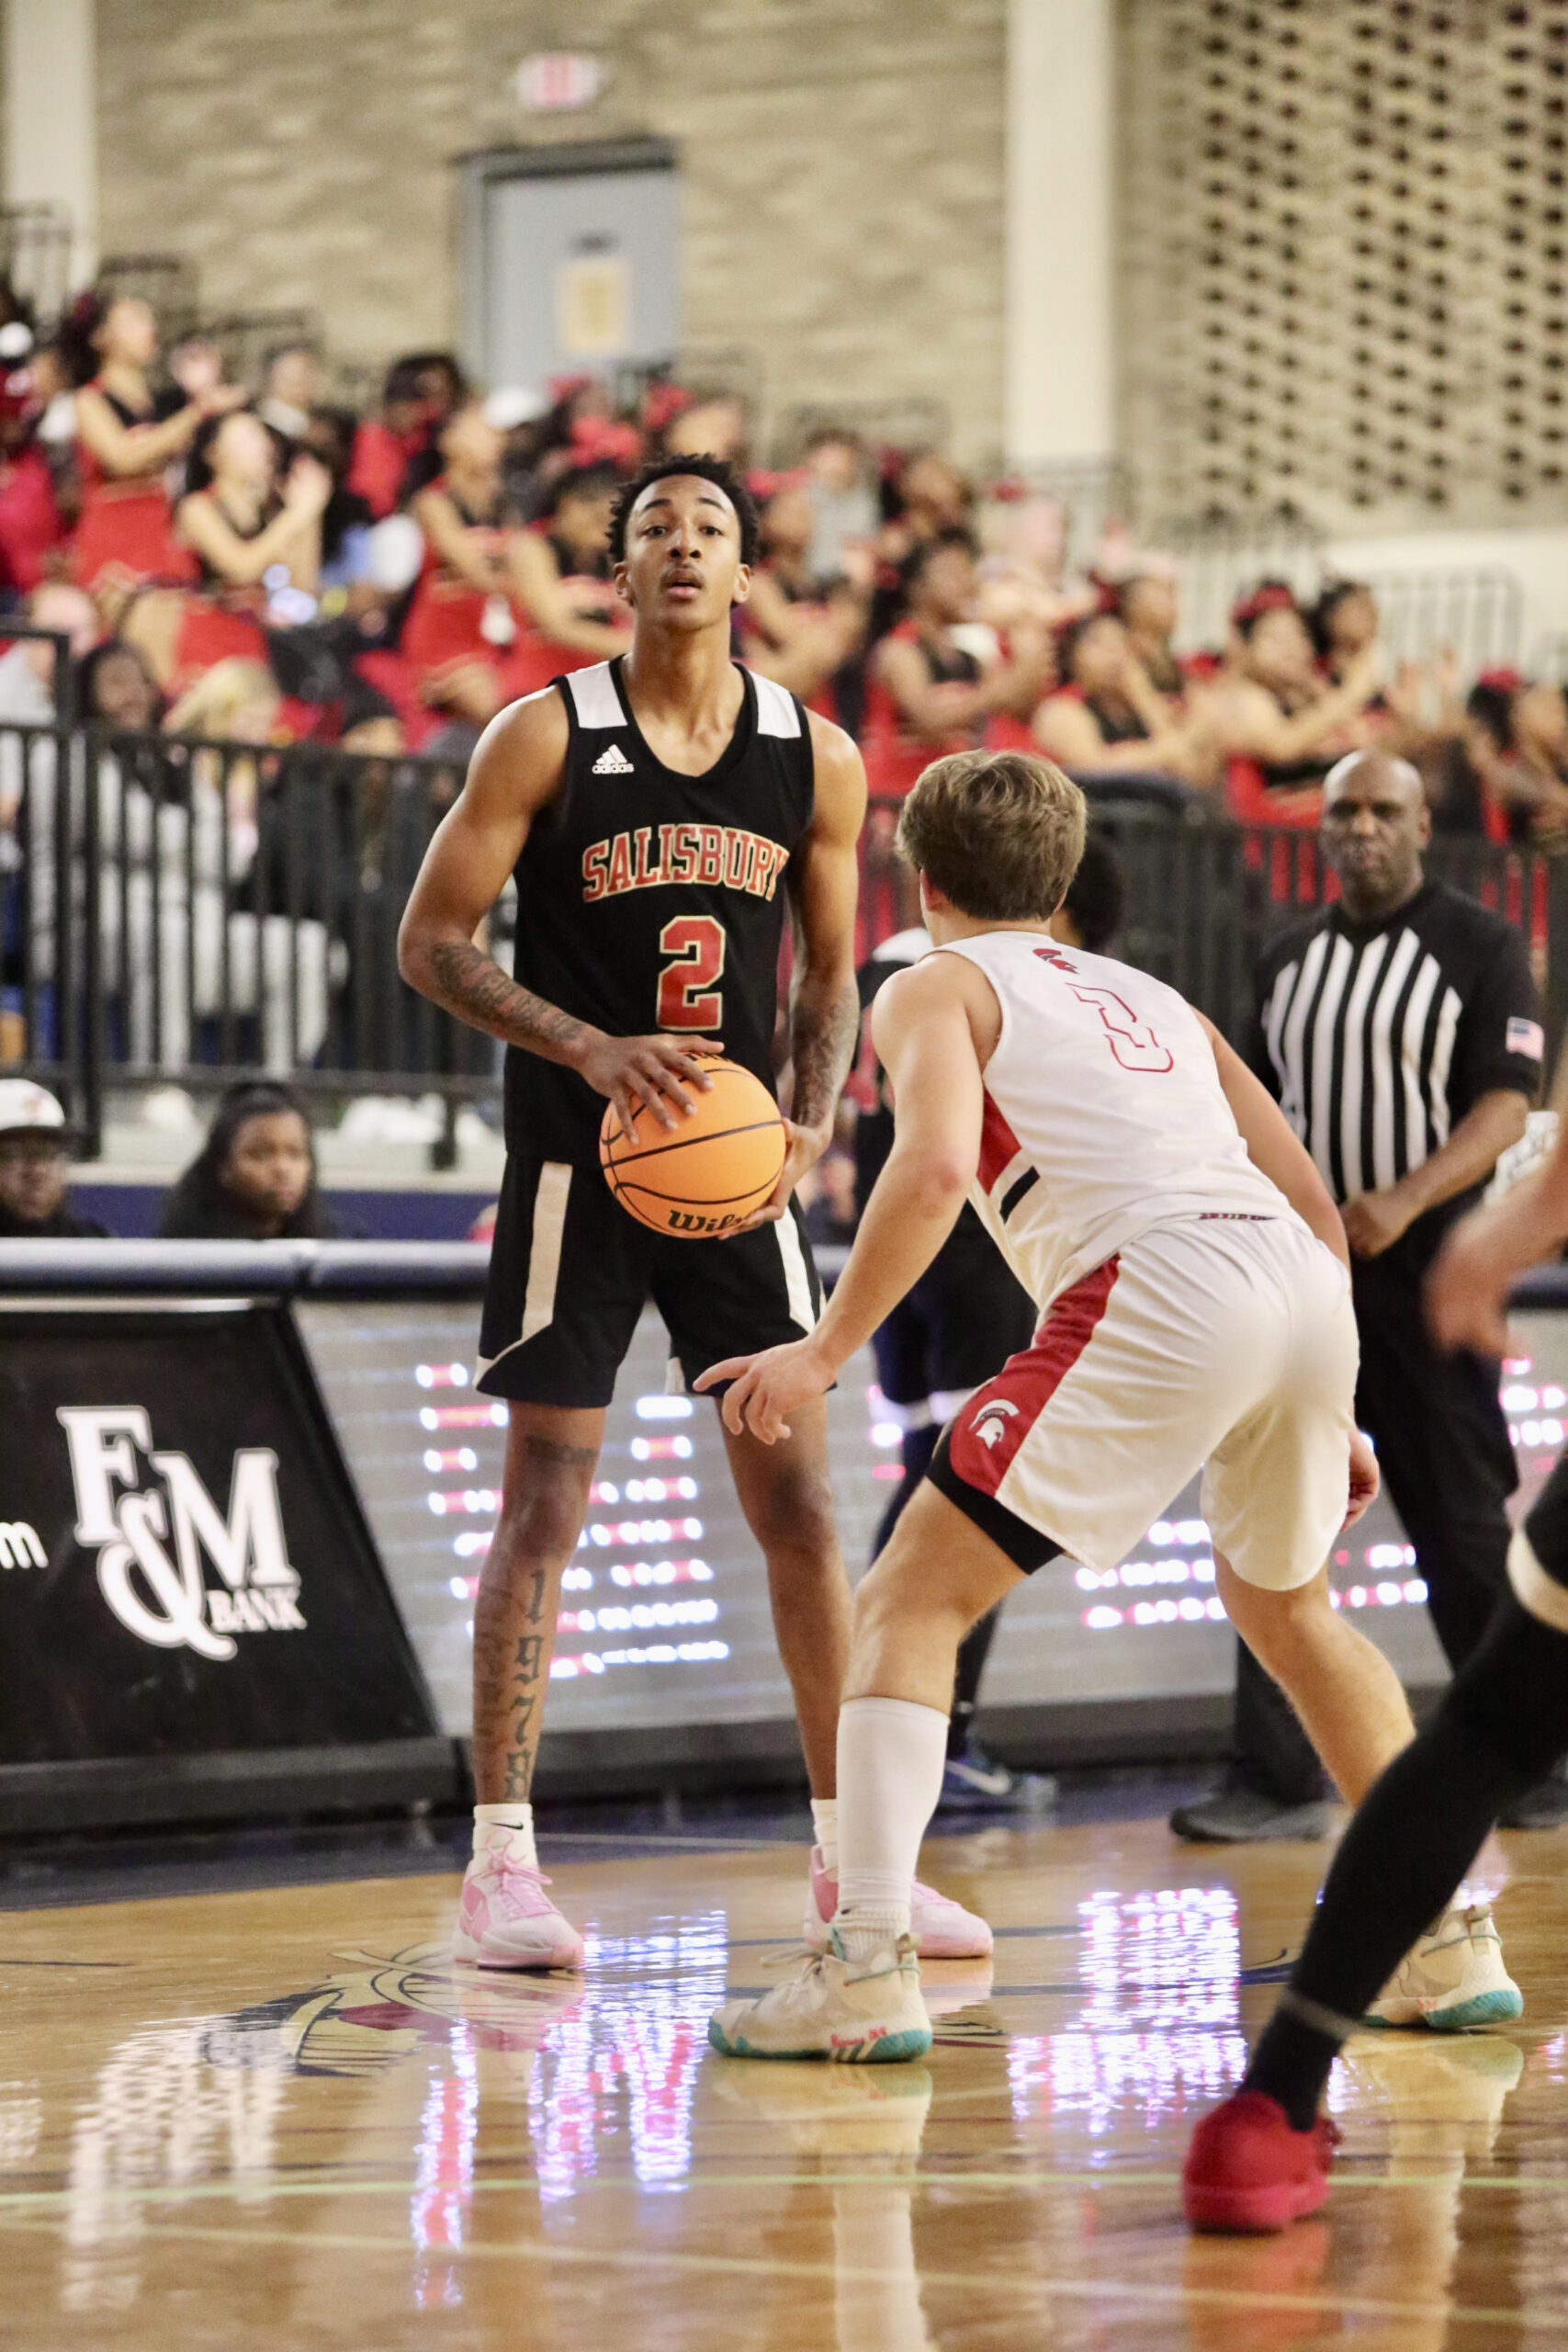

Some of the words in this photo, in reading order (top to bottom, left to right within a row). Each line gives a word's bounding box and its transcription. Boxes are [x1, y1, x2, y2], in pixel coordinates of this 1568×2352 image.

[592, 763, 635, 775] adidas
[582, 823, 790, 903] SALISBURY
[656, 915, 727, 1032] 2
[205, 1587, 308, 1633] BANK
